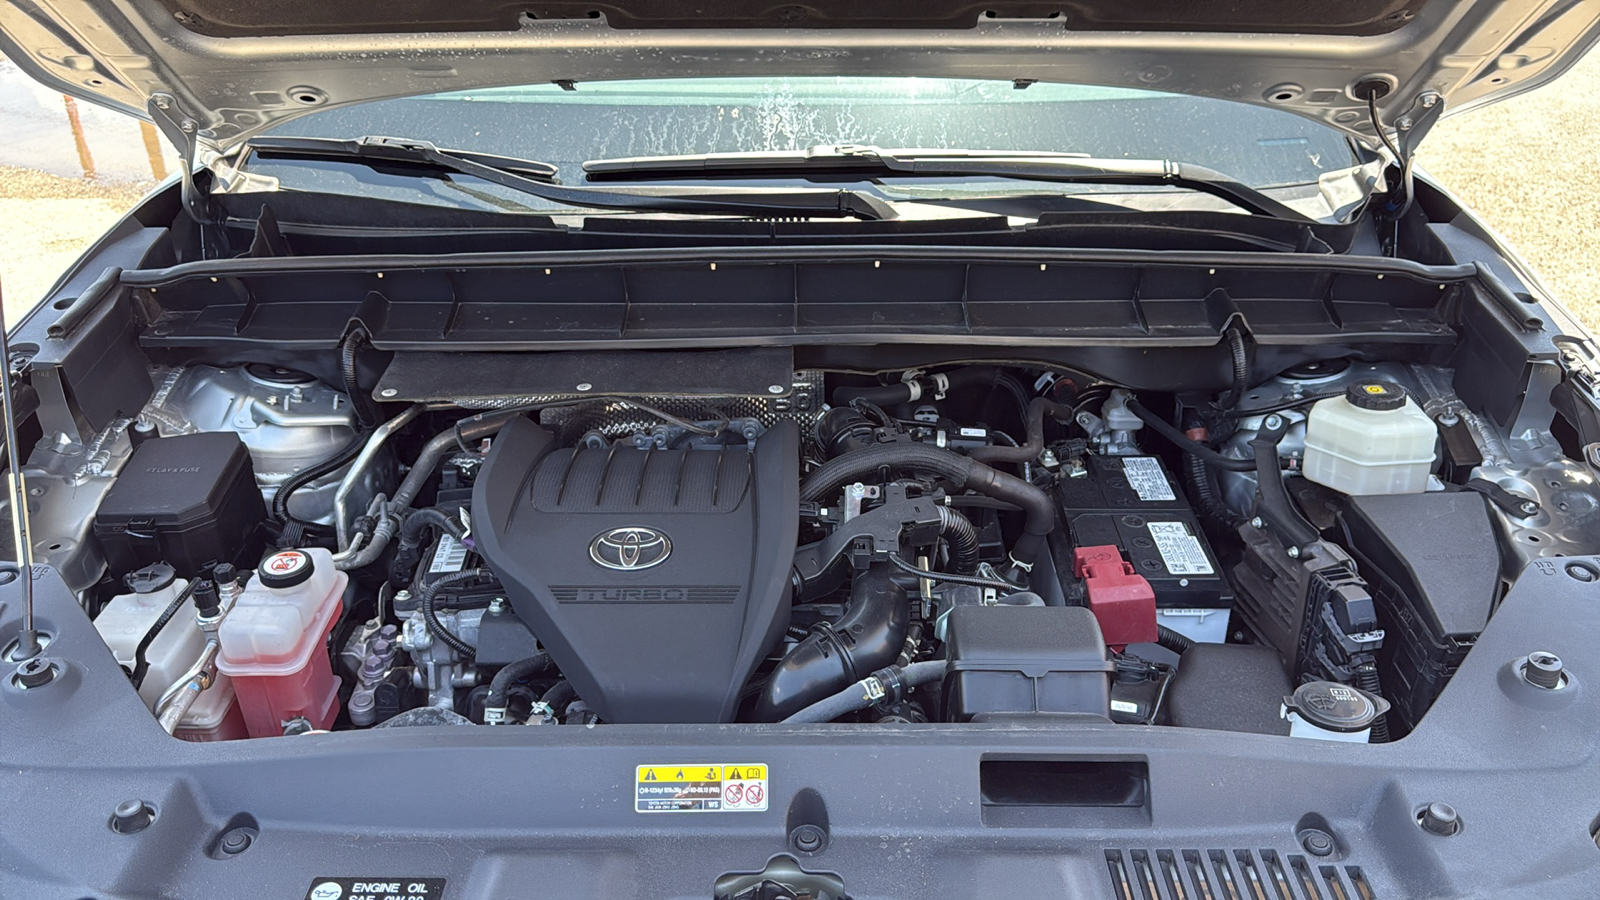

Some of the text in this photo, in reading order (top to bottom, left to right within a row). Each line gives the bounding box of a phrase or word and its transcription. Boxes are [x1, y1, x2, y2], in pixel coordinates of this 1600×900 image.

[580, 588, 684, 600] TURBO
[351, 882, 428, 893] ENGINE OIL
